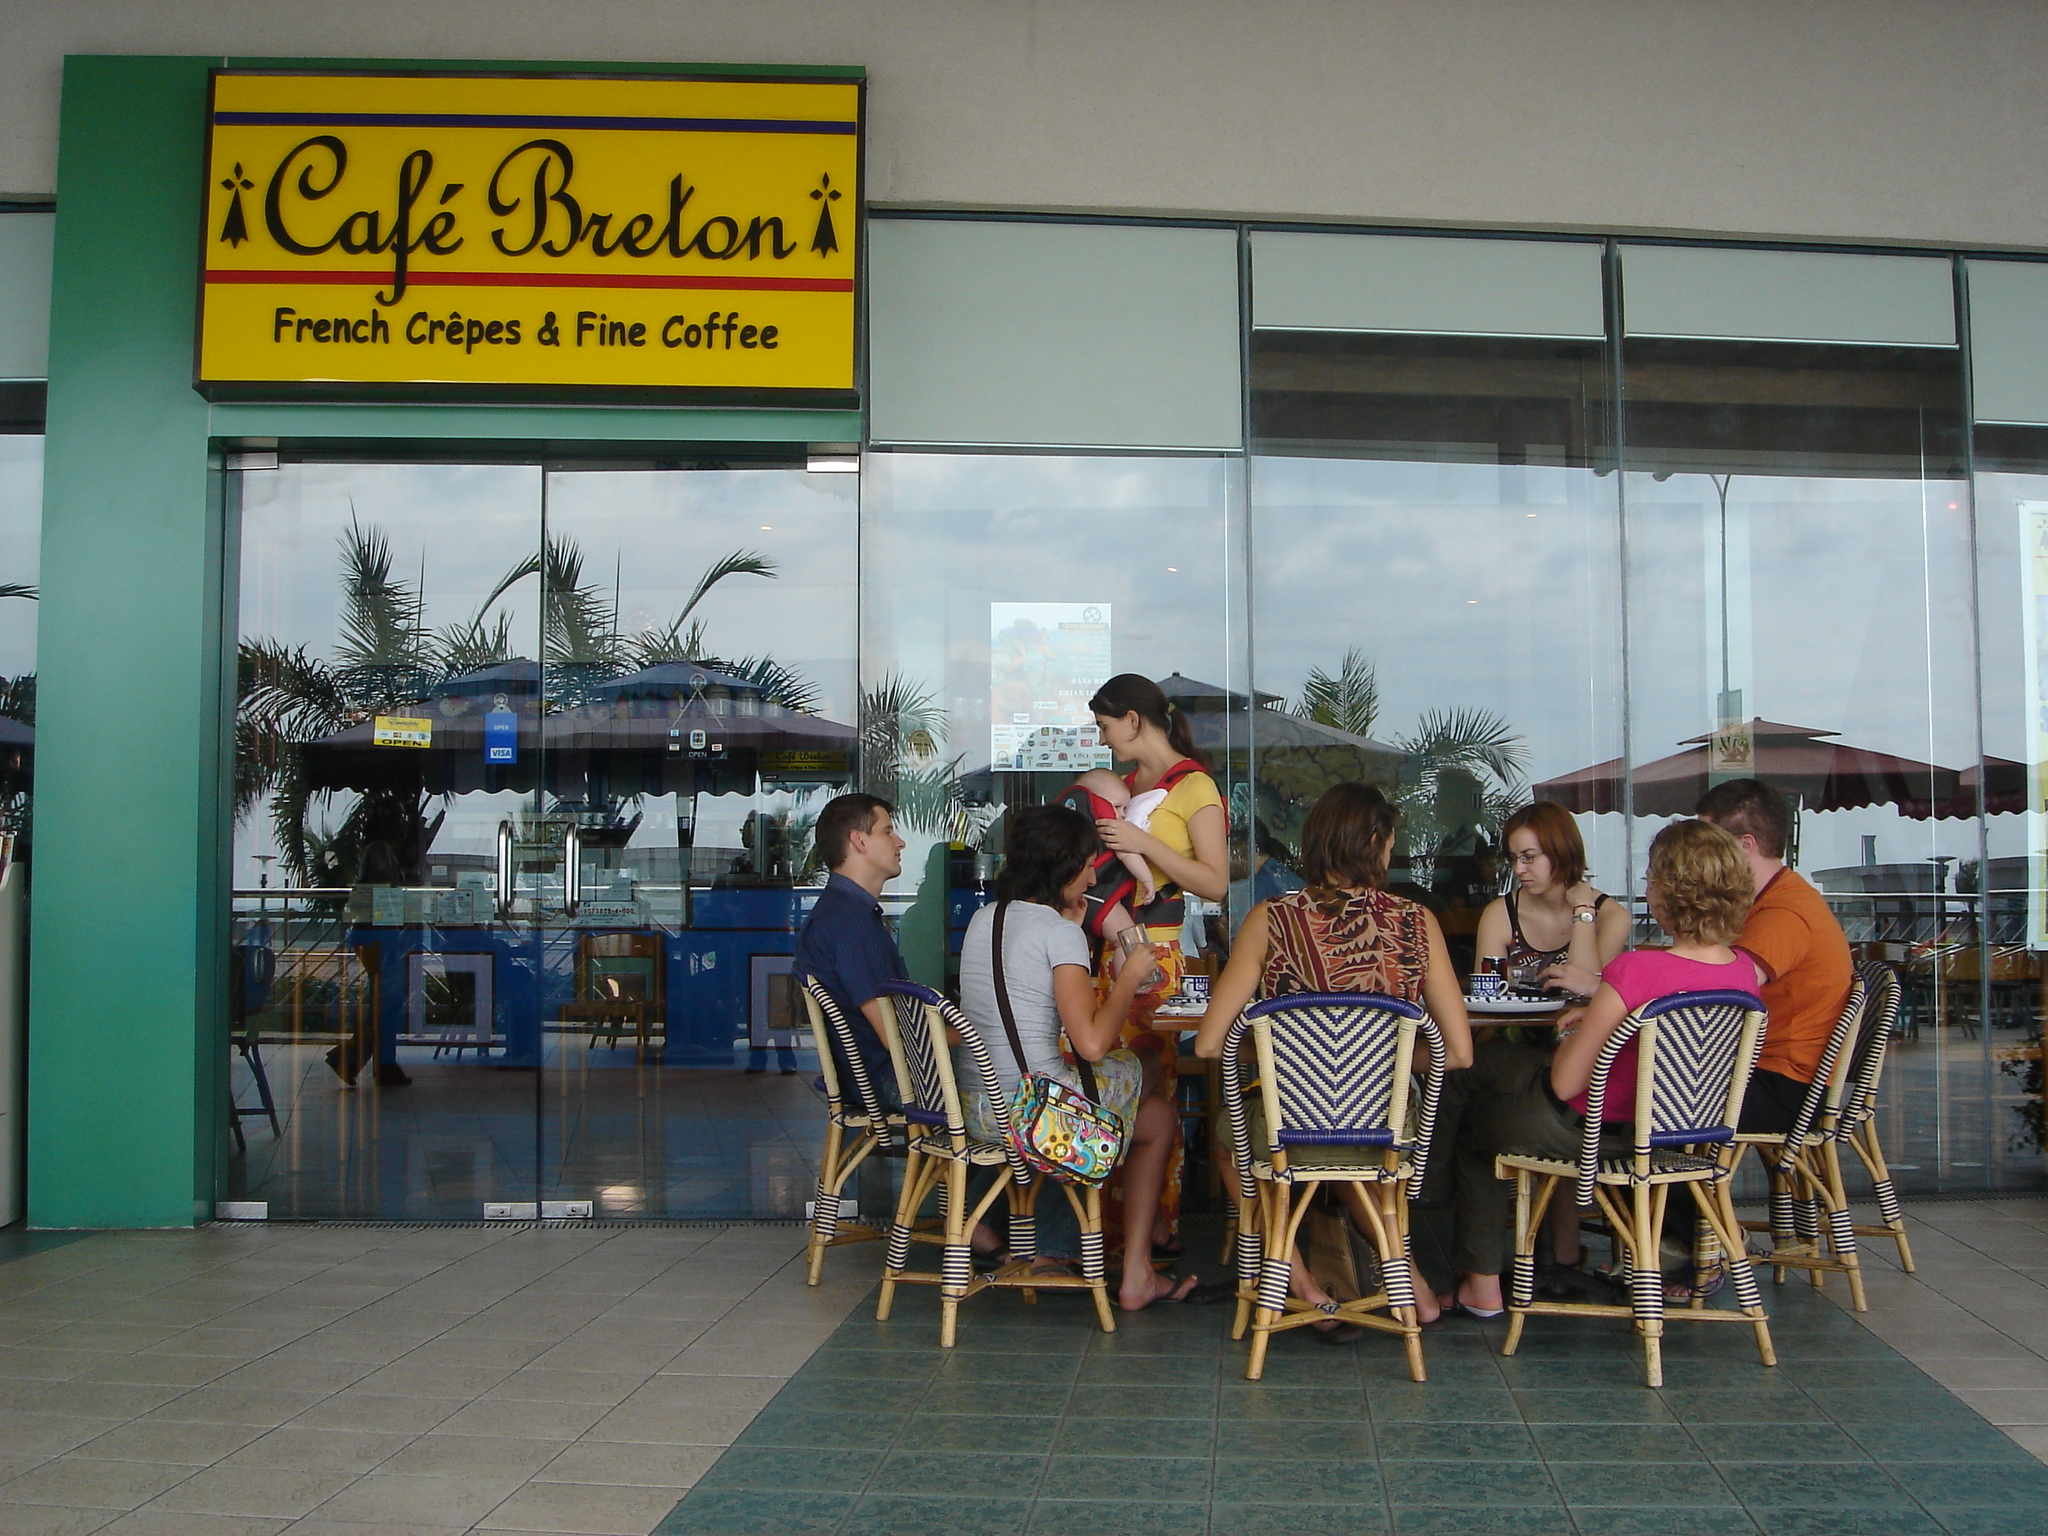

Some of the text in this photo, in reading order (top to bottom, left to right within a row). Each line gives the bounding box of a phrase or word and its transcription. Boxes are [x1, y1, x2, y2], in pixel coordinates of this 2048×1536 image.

[265, 135, 797, 306] Café Breton
[273, 307, 778, 355] French Crêpes & Fine Coffee
[491, 749, 511, 757] VISA
